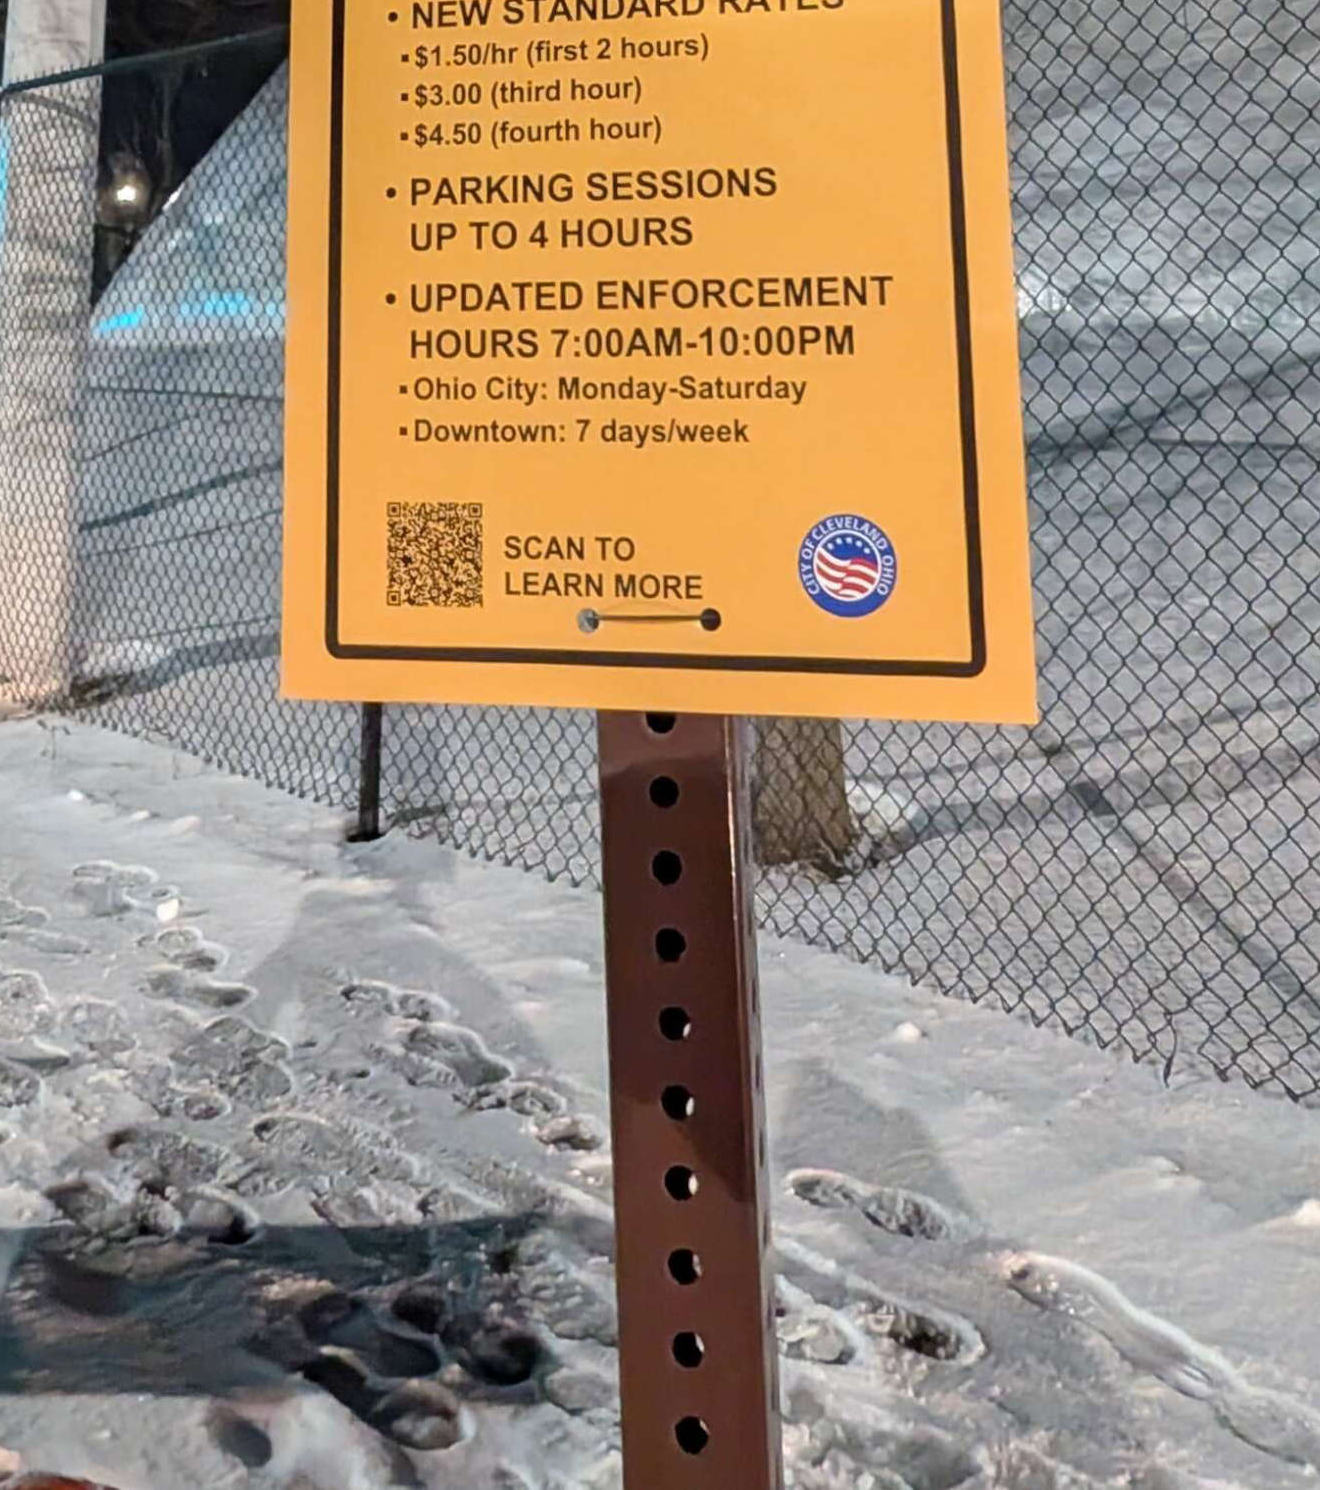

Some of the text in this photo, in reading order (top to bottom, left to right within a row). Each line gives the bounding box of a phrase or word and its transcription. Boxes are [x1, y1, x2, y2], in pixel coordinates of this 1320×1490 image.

[414, 32, 709, 70] $1.50/hr (first 2 hours)
[414, 75, 642, 110] $3.00 (third hour)
[414, 115, 662, 150] $4.50 (fourth hour)
[411, 167, 777, 207] PARKING SESSIONS
[410, 216, 693, 252] UP TO 4 HOURS
[410, 275, 894, 313] UPDATED ENFORCEMENT
[410, 324, 855, 359] HOURS 7:00AM-10:00PM
[413, 374, 807, 407] Ohio City: Monday-Saturday
[414, 418, 750, 449] Downtown: 7 days/week
[504, 535, 636, 562] SCAN TO
[800, 516, 895, 596] CITY OF CLEVELAND OHIO
[504, 571, 703, 600] LEARN MORE
